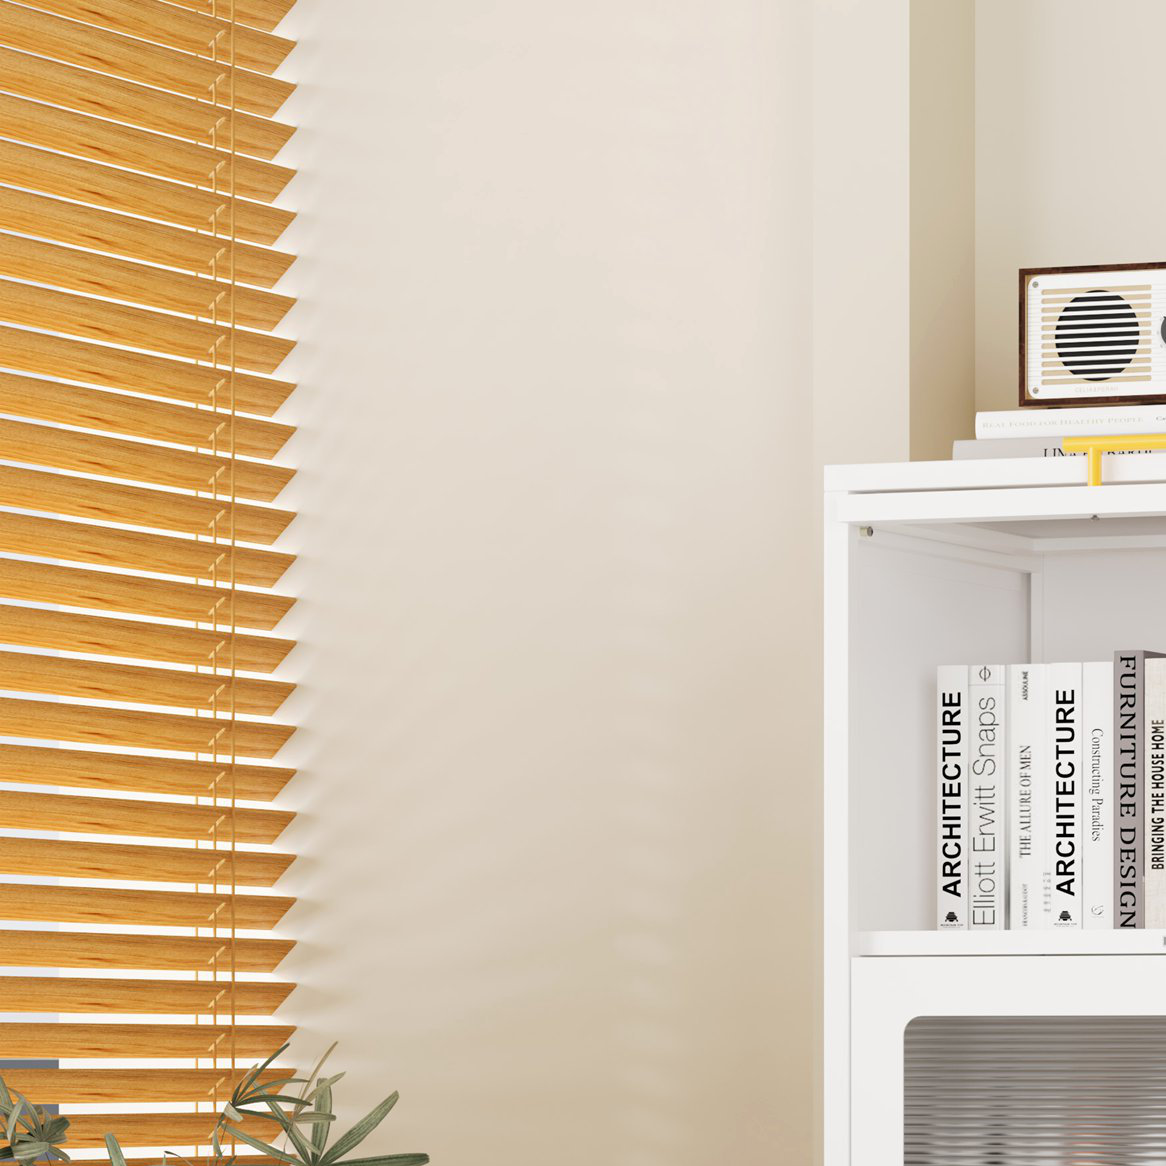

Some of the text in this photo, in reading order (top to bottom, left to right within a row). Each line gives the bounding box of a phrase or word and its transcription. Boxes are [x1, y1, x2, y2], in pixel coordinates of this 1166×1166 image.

[941, 691, 962, 898] ARCHITECTURE
[972, 696, 1000, 926] Elliott Erwitt Snaps
[1019, 745, 1032, 858] THE ALLURE OF MEN
[1055, 689, 1076, 897] ARCHITECTURE
[1088, 728, 1105, 795] Constructing
[1120, 655, 1137, 929] FURNITURE DESIGN
[1151, 719, 1165, 870] BRINGING THE HOUSE HOME
